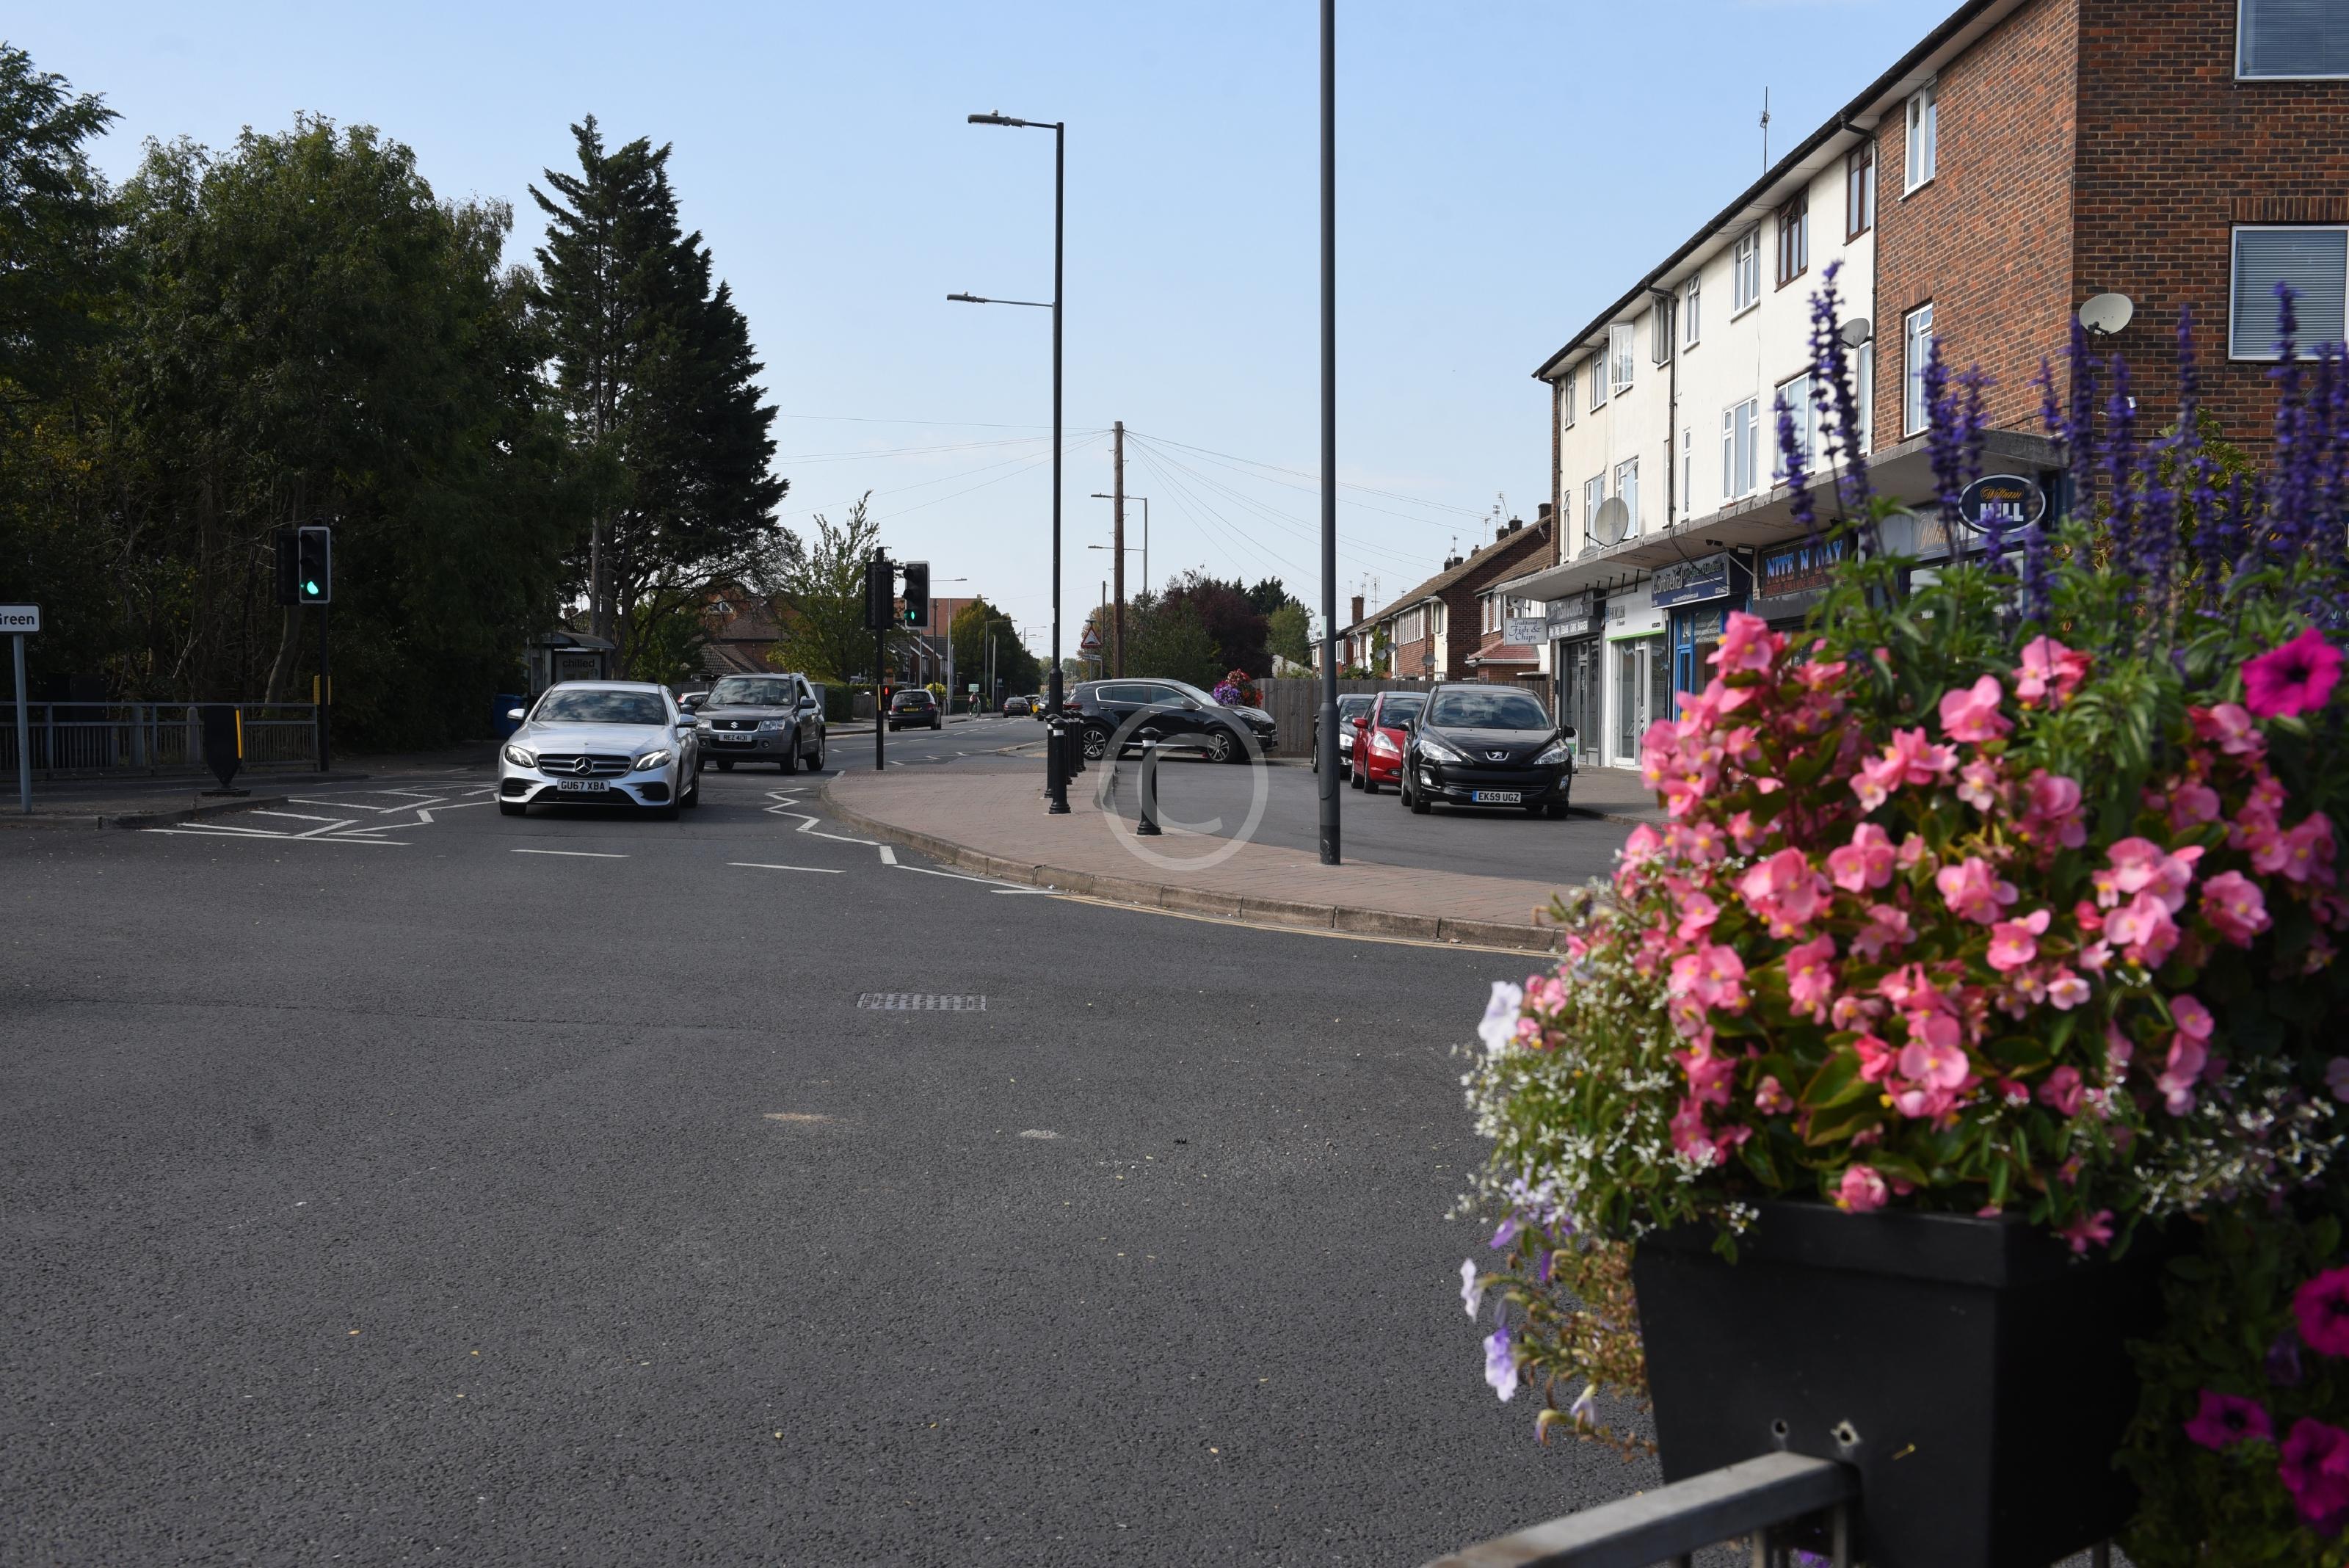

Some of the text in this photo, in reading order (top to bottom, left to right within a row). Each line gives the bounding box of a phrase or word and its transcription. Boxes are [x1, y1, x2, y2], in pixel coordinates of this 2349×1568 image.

[1980, 486, 2024, 501] William
[1980, 503, 2024, 522] HILL
[1653, 564, 1683, 594] Continental
[0, 612, 35, 625] reen
[1508, 625, 1528, 636] Fish
[1515, 632, 1536, 642] Chips
[562, 658, 595, 667] chilled
[561, 780, 605, 791] GU67 XBA
[1478, 792, 1520, 802] EK59 UGZ
